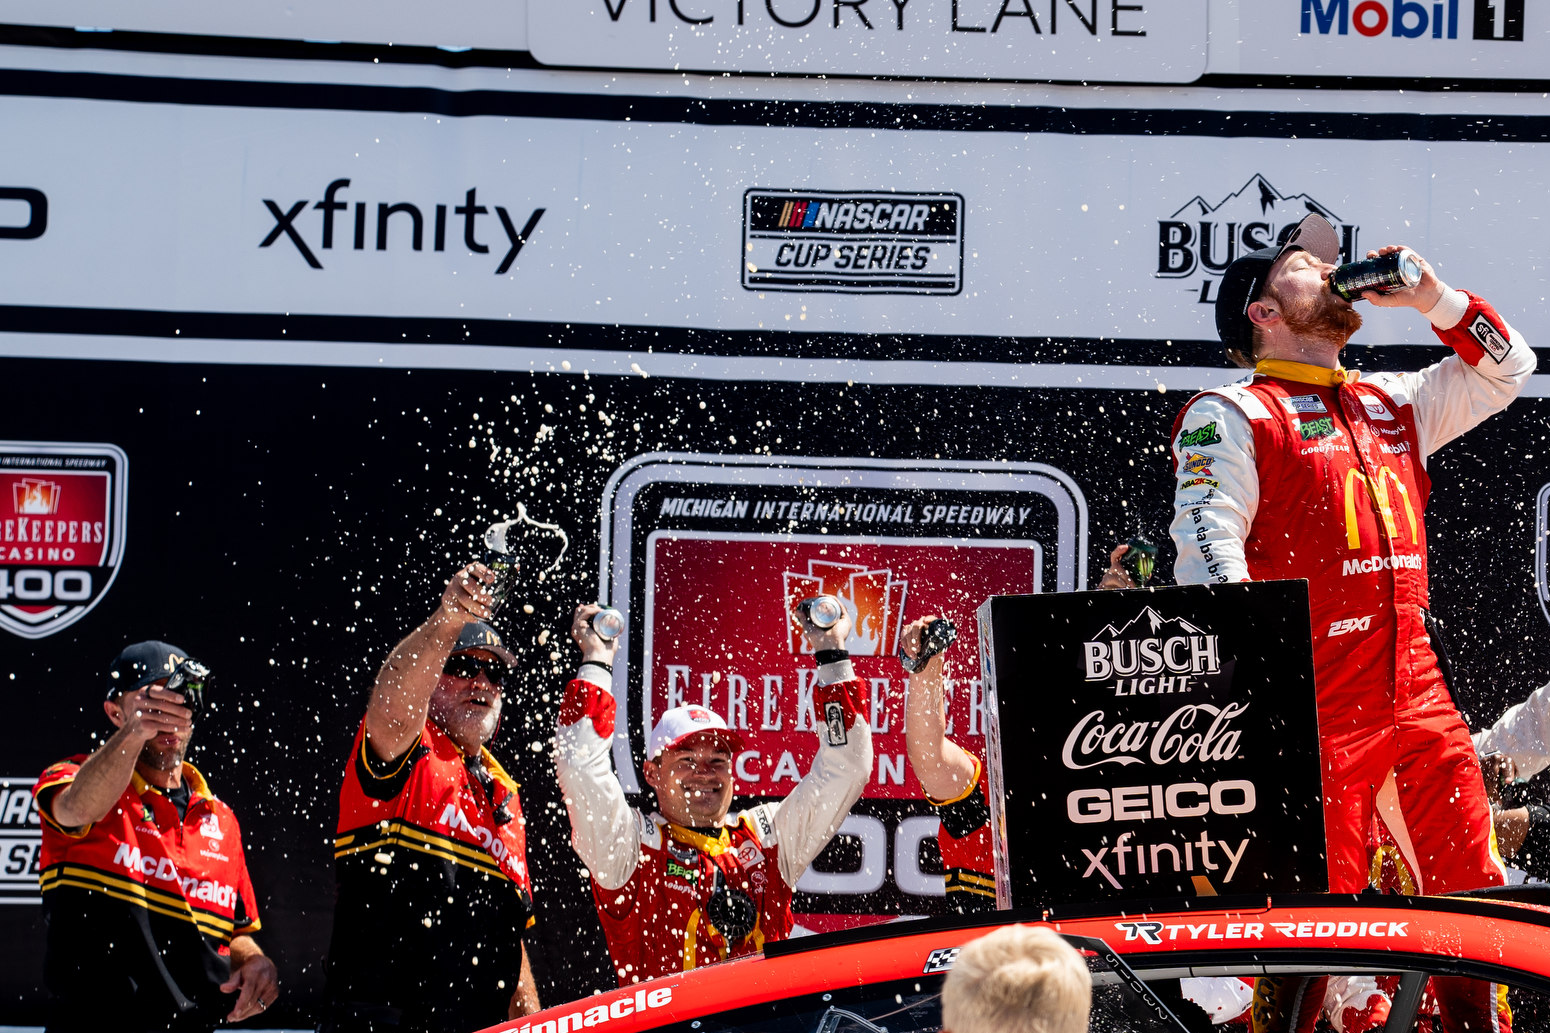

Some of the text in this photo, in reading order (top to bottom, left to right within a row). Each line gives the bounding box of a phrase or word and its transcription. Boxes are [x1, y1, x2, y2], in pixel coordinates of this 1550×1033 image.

[1300, 0, 1458, 39] Mobil
[259, 178, 547, 274] xfinity
[815, 203, 930, 231] NASCAR
[775, 243, 931, 270] CUP SERIES
[1300, 416, 1335, 441] BEAST
[1183, 455, 1215, 474] SUNOCO
[660, 497, 1032, 525] MICHIGAN INTERNATIONAL SPEEDWAY
[0, 516, 103, 544] EKEEPERS
[1083, 634, 1221, 682] BUSCH
[1115, 675, 1190, 696] LIGHT
[1062, 701, 1250, 770] Coca-Cola
[1066, 780, 1257, 824] GEICO
[1081, 830, 1250, 890] xfinity
[1165, 922, 1265, 940] TYLER
[1268, 920, 1410, 939] REDDICK
